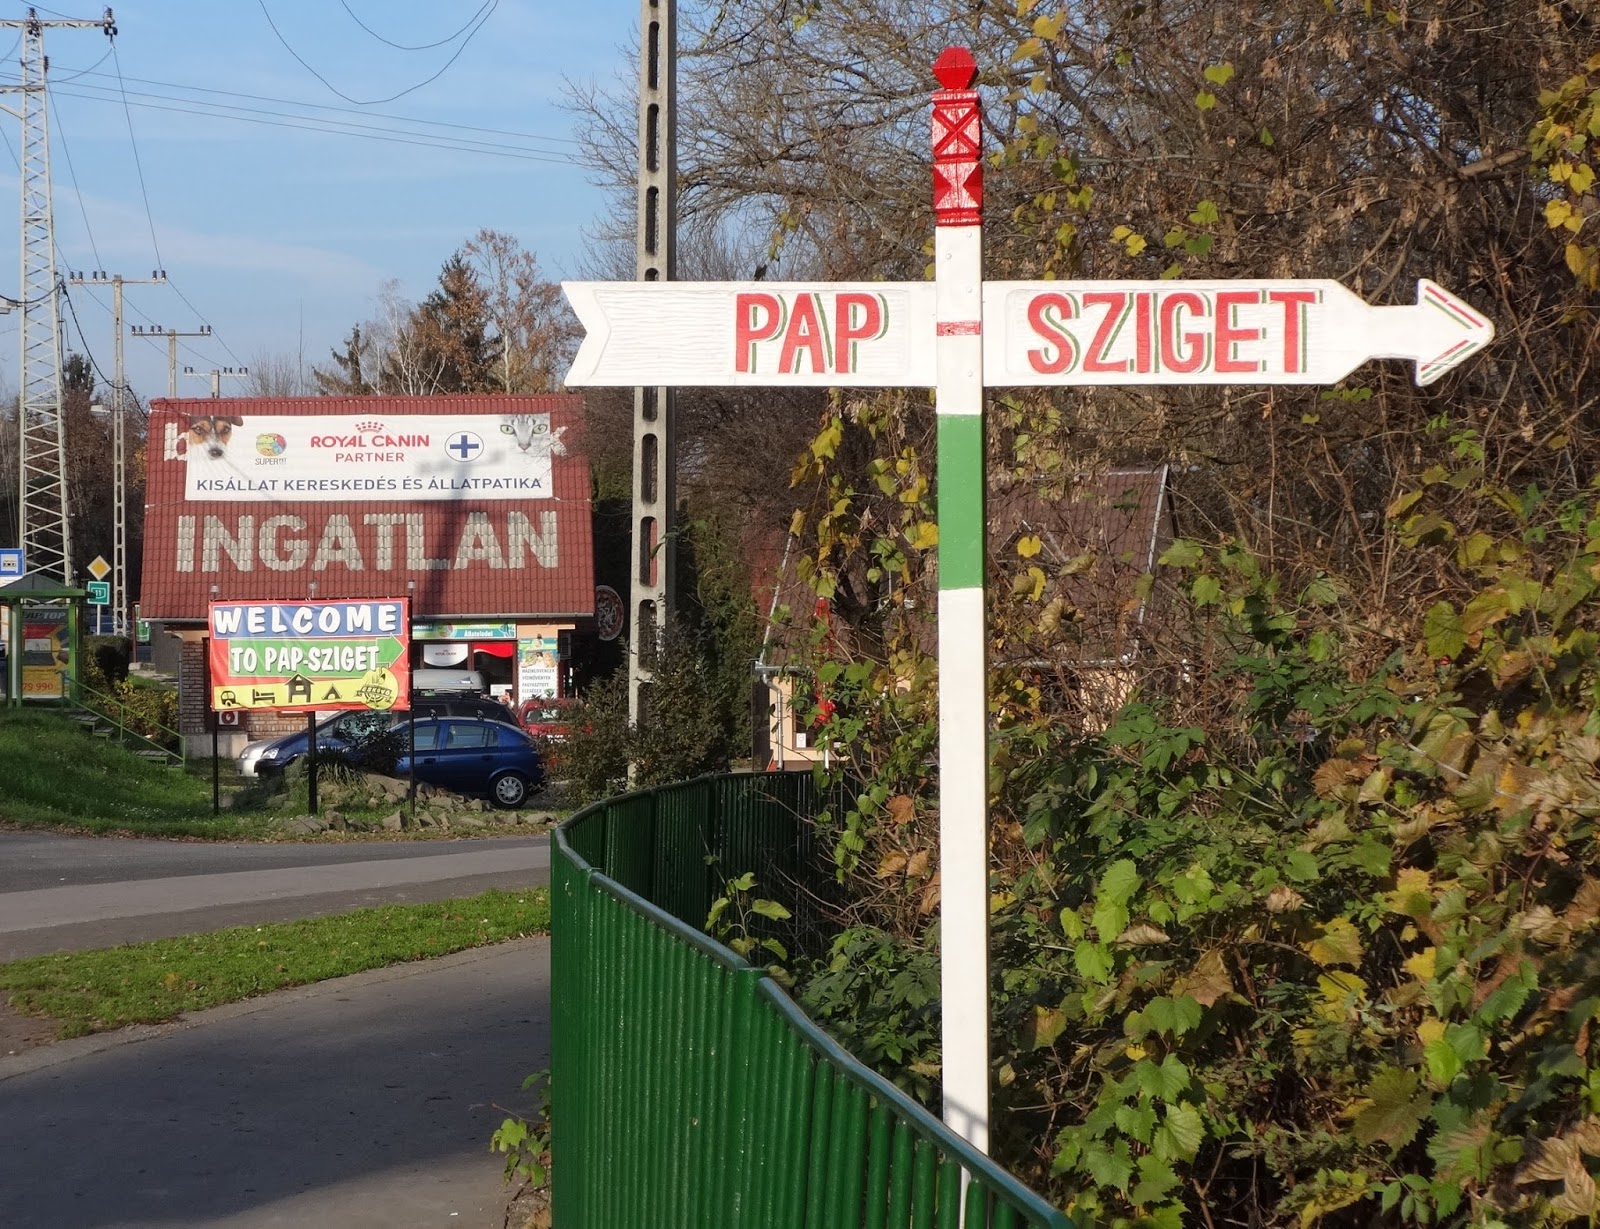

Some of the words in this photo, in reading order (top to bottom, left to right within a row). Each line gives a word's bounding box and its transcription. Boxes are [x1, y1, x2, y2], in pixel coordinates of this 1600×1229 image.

[735, 292, 889, 374] PAP
[1027, 289, 1324, 374] SZIGET
[310, 435, 367, 448] ROYAL
[371, 434, 430, 447] CANIN
[335, 452, 405, 463] PARTNER
[196, 476, 279, 491] KISÁLLAT
[284, 475, 397, 491] KERESKEDÉS
[402, 475, 423, 490] ÉS
[428, 475, 542, 490] ÁLLATPATIKA
[176, 510, 559, 573] INGATLAN
[213, 604, 398, 634] WELCOME
[230, 646, 258, 673] TO
[264, 645, 380, 673] PAP-SZIGET
